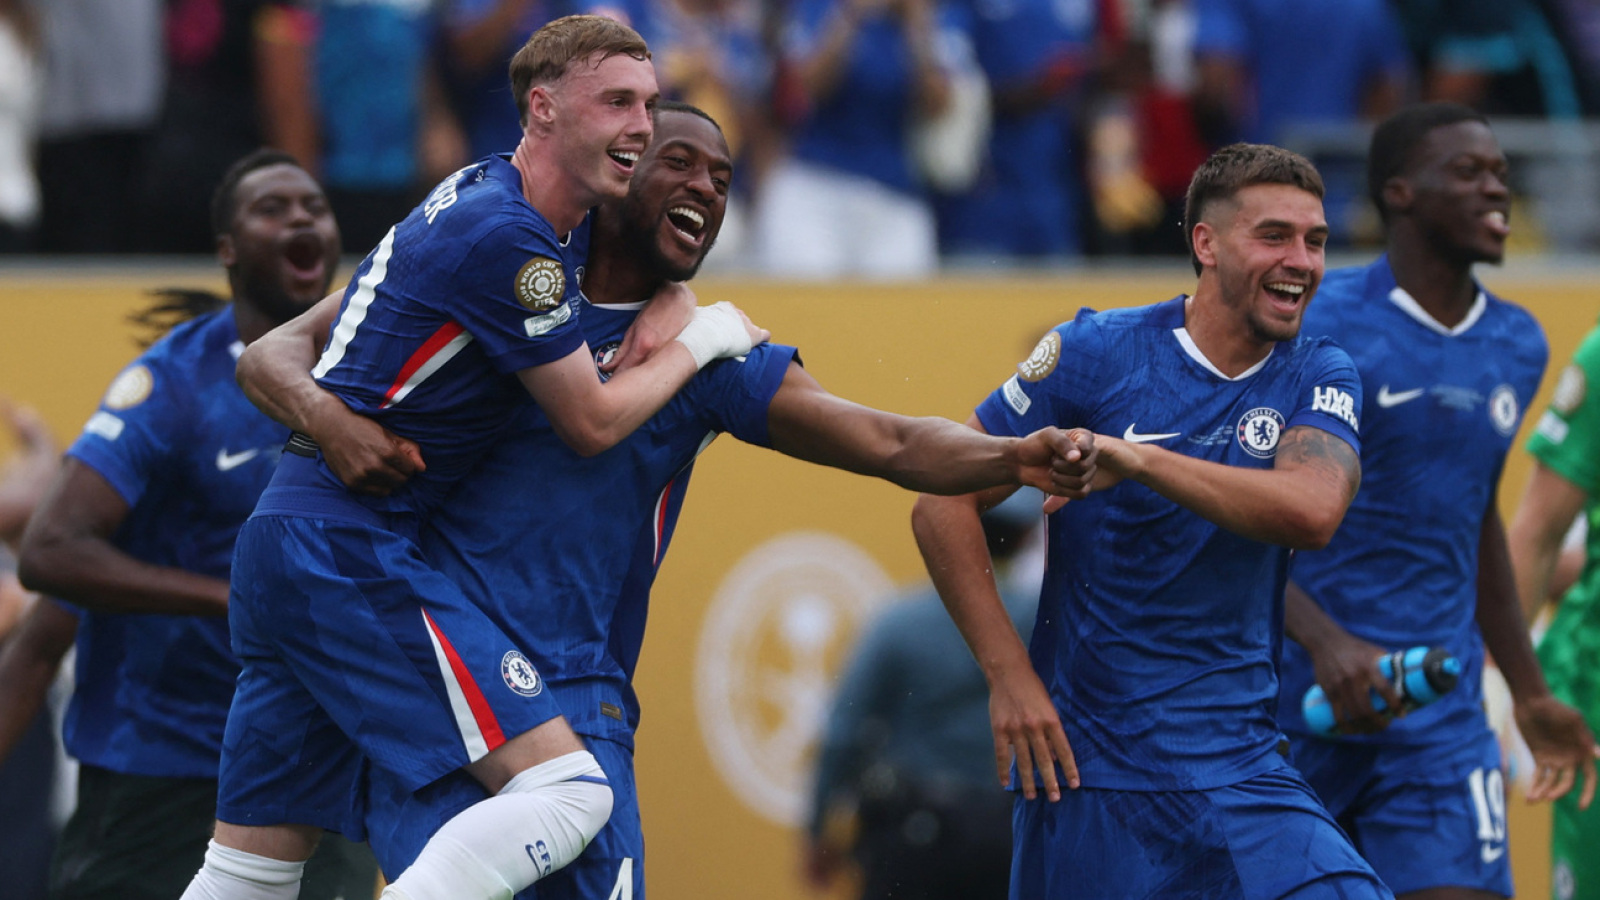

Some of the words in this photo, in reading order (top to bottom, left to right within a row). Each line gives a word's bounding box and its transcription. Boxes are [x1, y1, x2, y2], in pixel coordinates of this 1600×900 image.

[520, 262, 541, 284] WORLD
[542, 261, 556, 269] CUP
[1244, 409, 1278, 421] CHELSEA
[1468, 766, 1505, 843] 19
